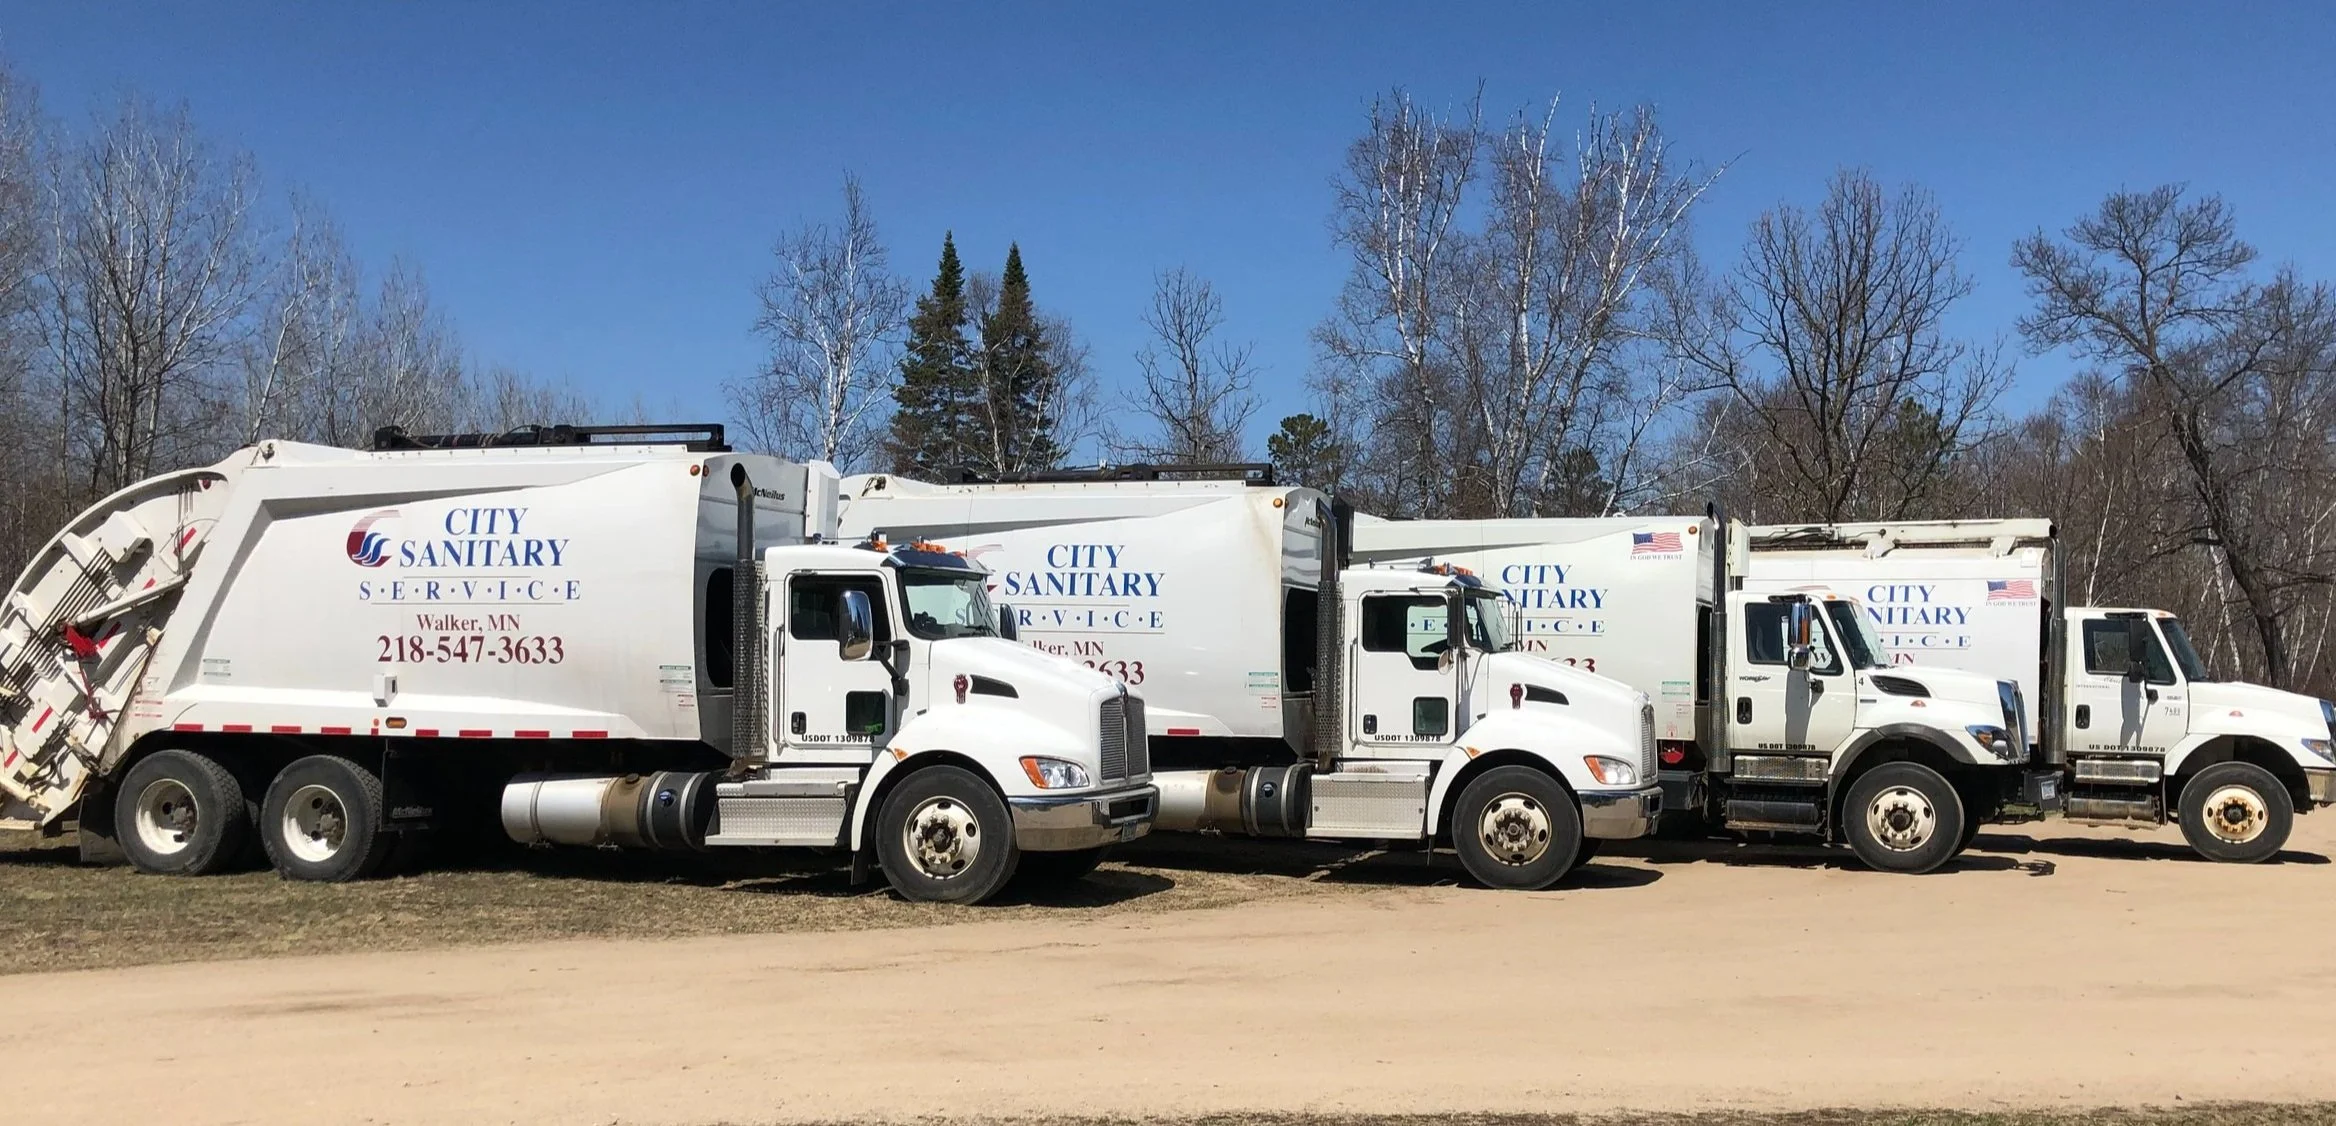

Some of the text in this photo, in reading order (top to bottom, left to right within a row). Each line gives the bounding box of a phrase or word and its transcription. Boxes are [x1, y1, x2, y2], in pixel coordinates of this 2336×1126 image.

[445, 507, 529, 536] CITY
[399, 539, 570, 568] SANITARY
[1047, 544, 1126, 569] CITY
[1005, 571, 1165, 597] SANITARY
[1502, 564, 1573, 585] CITY
[1500, 588, 1609, 609] NITARY
[1867, 585, 1937, 604] CITY
[416, 614, 520, 633] Walker, MN
[1867, 607, 1973, 625] NITARY
[377, 635, 565, 664] 218-547-3633
[1073, 641, 1105, 656] MN
[1858, 677, 1864, 686] 4
[801, 734, 875, 744] USDOT 1309878
[1374, 734, 1402, 742] USDOT
